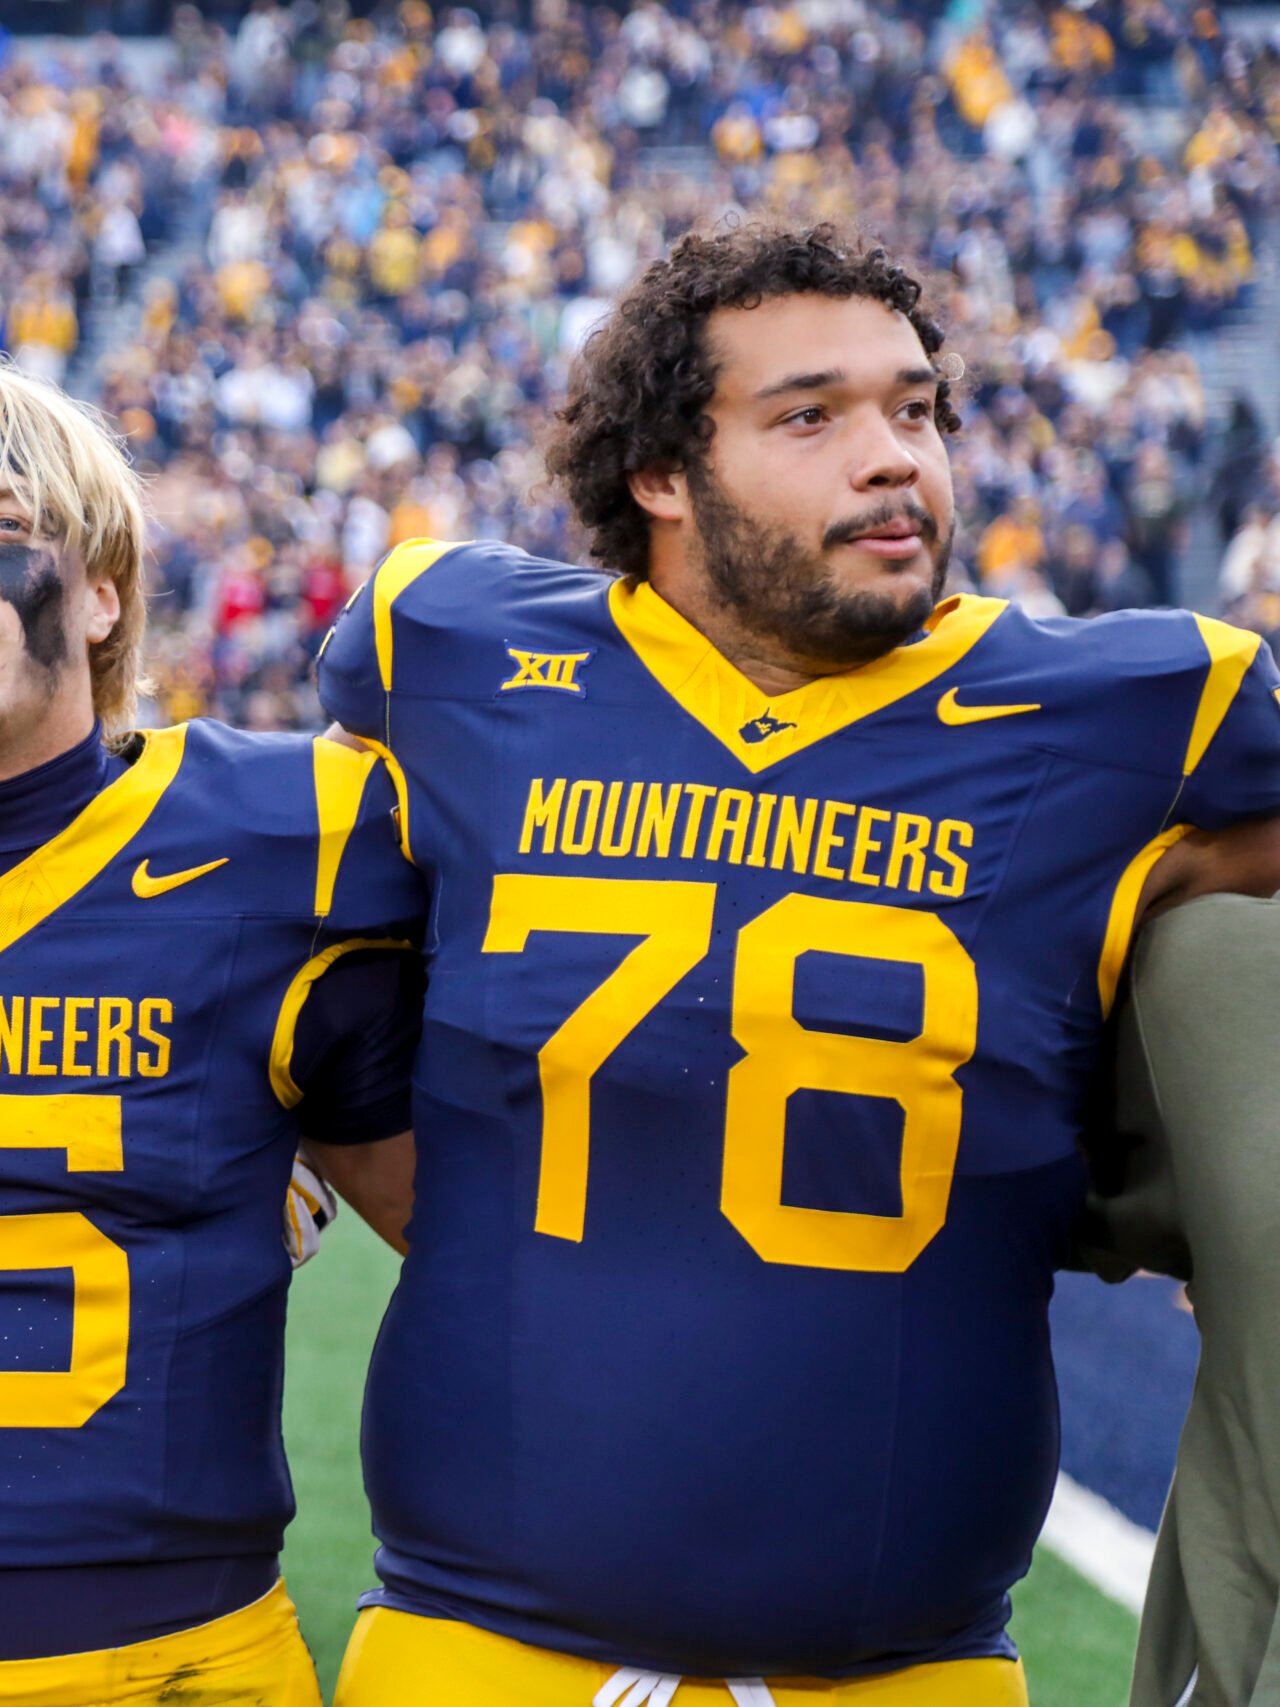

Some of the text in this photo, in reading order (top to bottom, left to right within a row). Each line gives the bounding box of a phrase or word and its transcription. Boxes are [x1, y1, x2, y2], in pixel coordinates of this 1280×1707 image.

[501, 648, 589, 692] XII
[519, 778, 974, 898] MOUNTAINEERS
[481, 873, 979, 1273] 78
